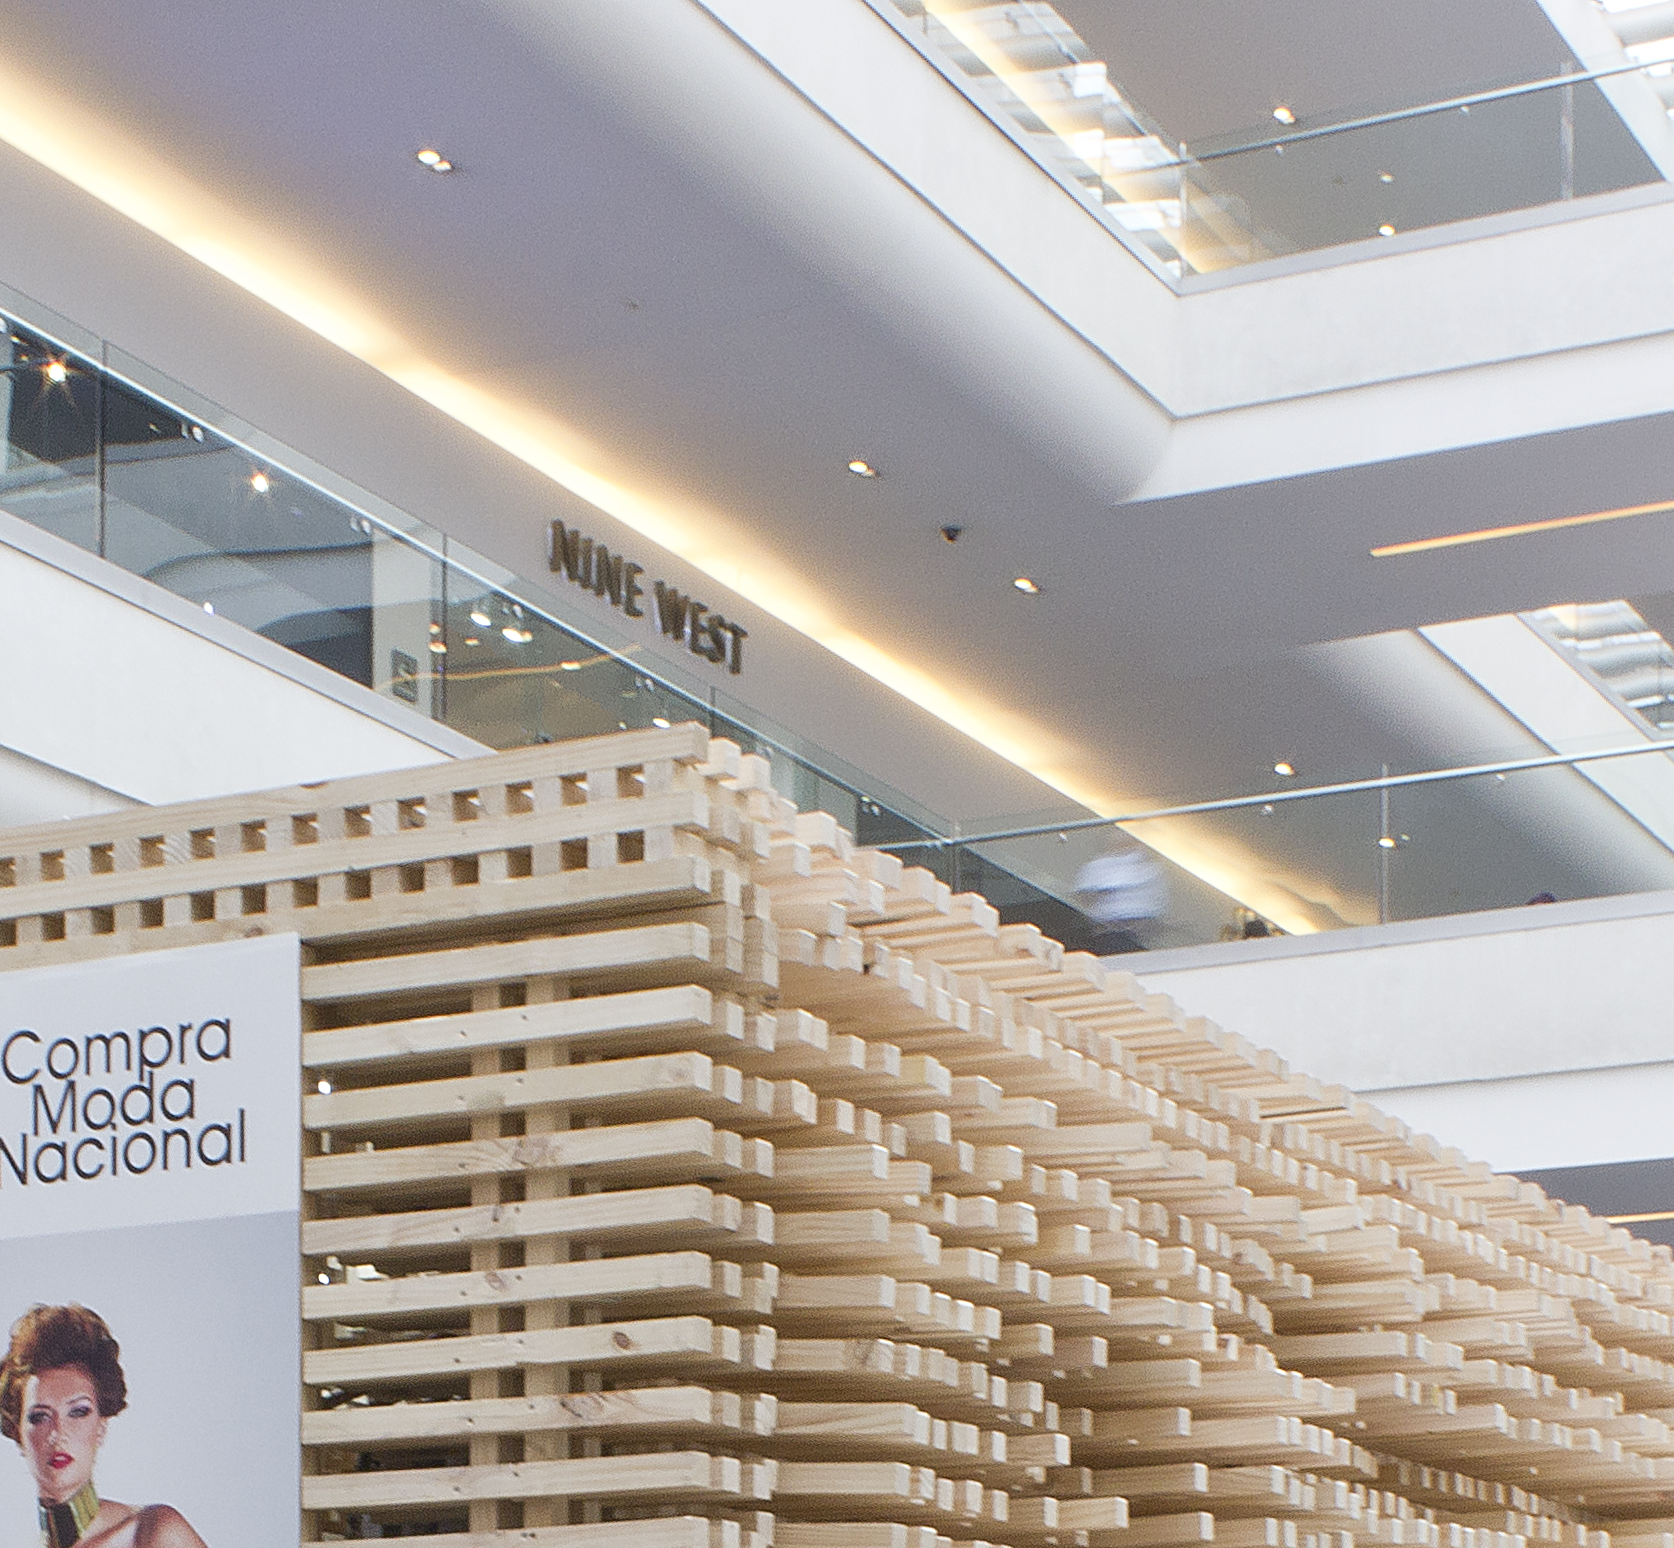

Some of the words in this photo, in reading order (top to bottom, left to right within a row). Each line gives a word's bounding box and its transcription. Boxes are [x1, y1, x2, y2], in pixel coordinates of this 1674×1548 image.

[548, 519, 644, 619] NINE
[653, 580, 749, 676] WEST
[0, 1017, 232, 1085] Compra
[32, 1070, 195, 1136] Moda
